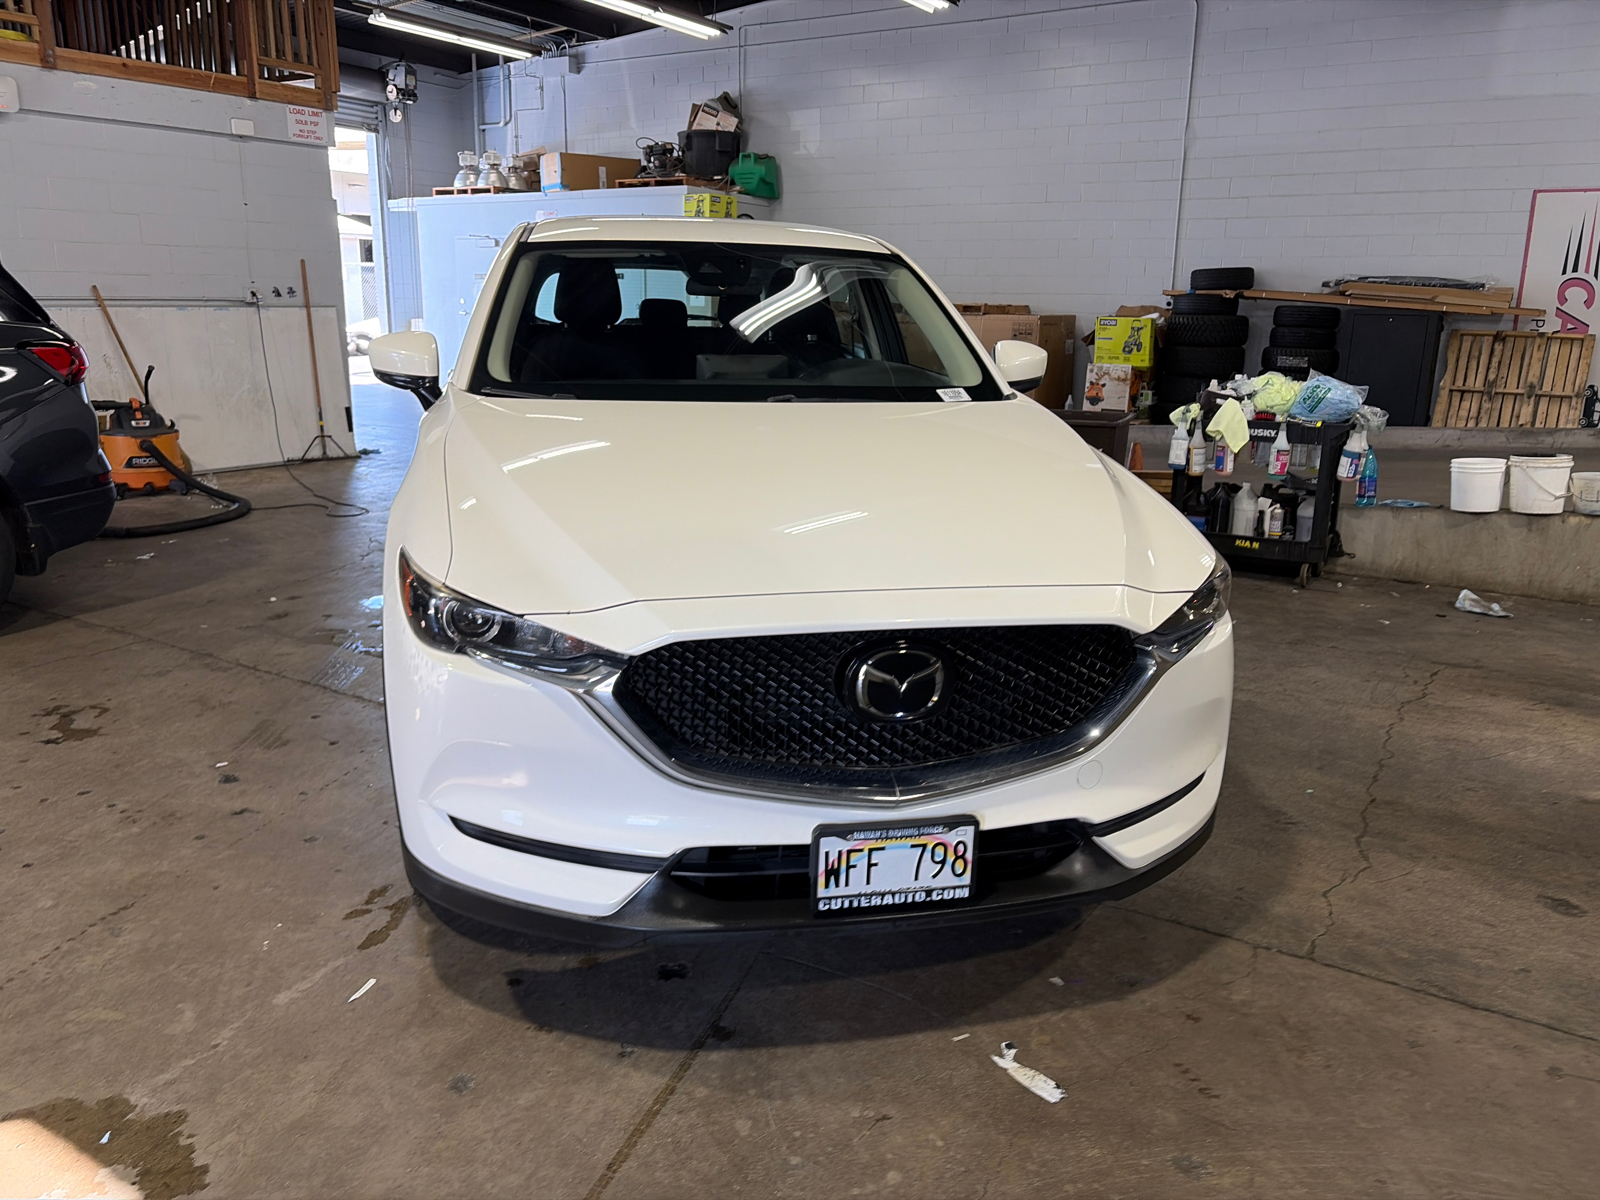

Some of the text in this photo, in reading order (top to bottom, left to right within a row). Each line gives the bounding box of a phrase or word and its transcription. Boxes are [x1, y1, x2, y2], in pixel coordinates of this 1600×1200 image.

[288, 108, 323, 118] LOAD LIMIT
[1235, 538, 1251, 548] KIA
[887, 826, 919, 838] DRIVING
[919, 824, 945, 835] FORCE
[824, 840, 968, 890] WFF 798
[817, 886, 970, 911] CUTTERAUTO.COM
